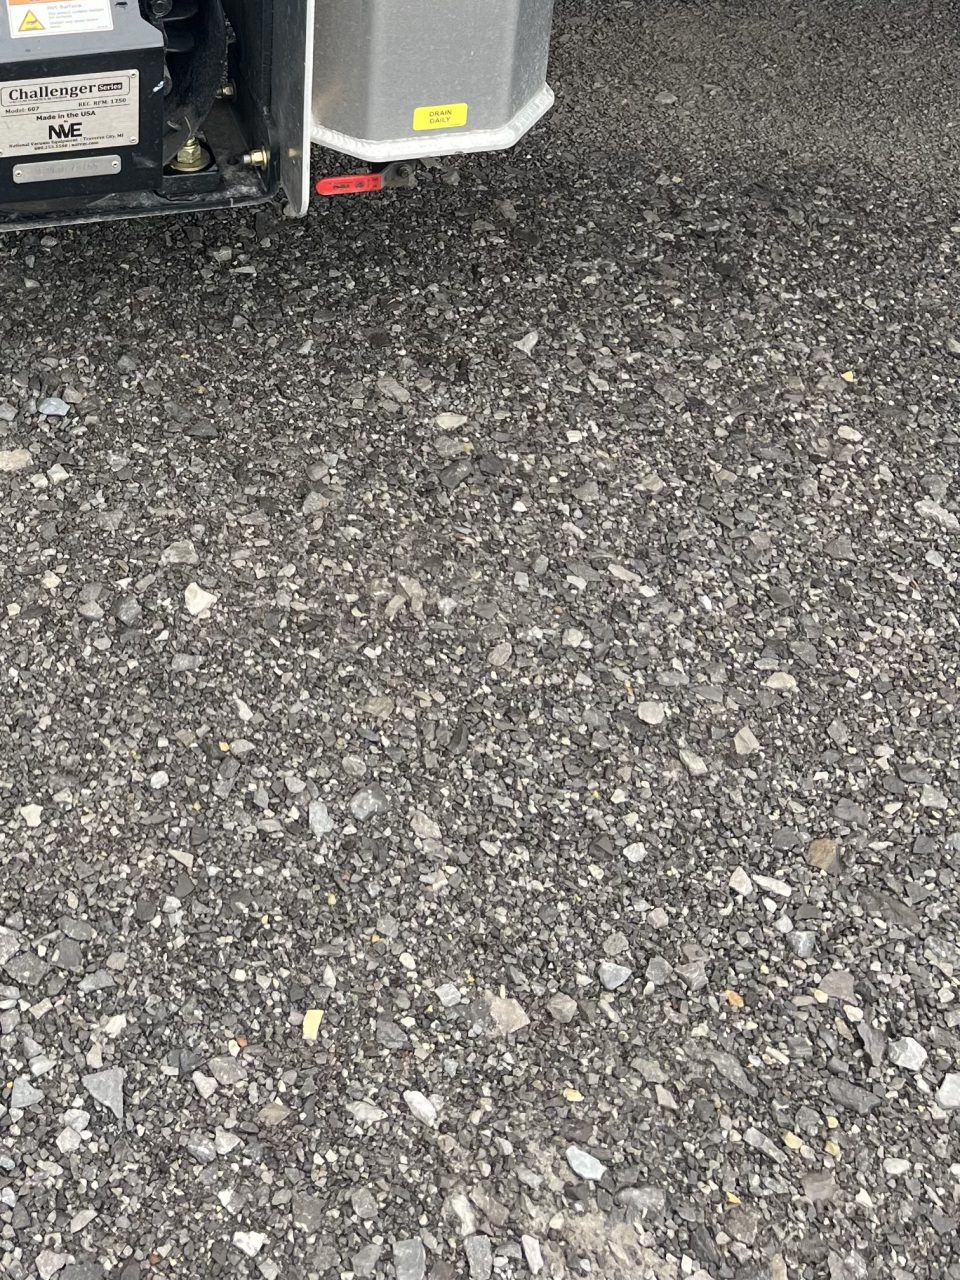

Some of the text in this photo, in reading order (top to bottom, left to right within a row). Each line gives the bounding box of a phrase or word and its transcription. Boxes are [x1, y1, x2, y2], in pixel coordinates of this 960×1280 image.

[8, 83, 97, 101] Challenger
[99, 82, 122, 91] Series
[36, 113, 56, 121] Made
[429, 109, 452, 117] DRAIN
[48, 122, 82, 140] NVE
